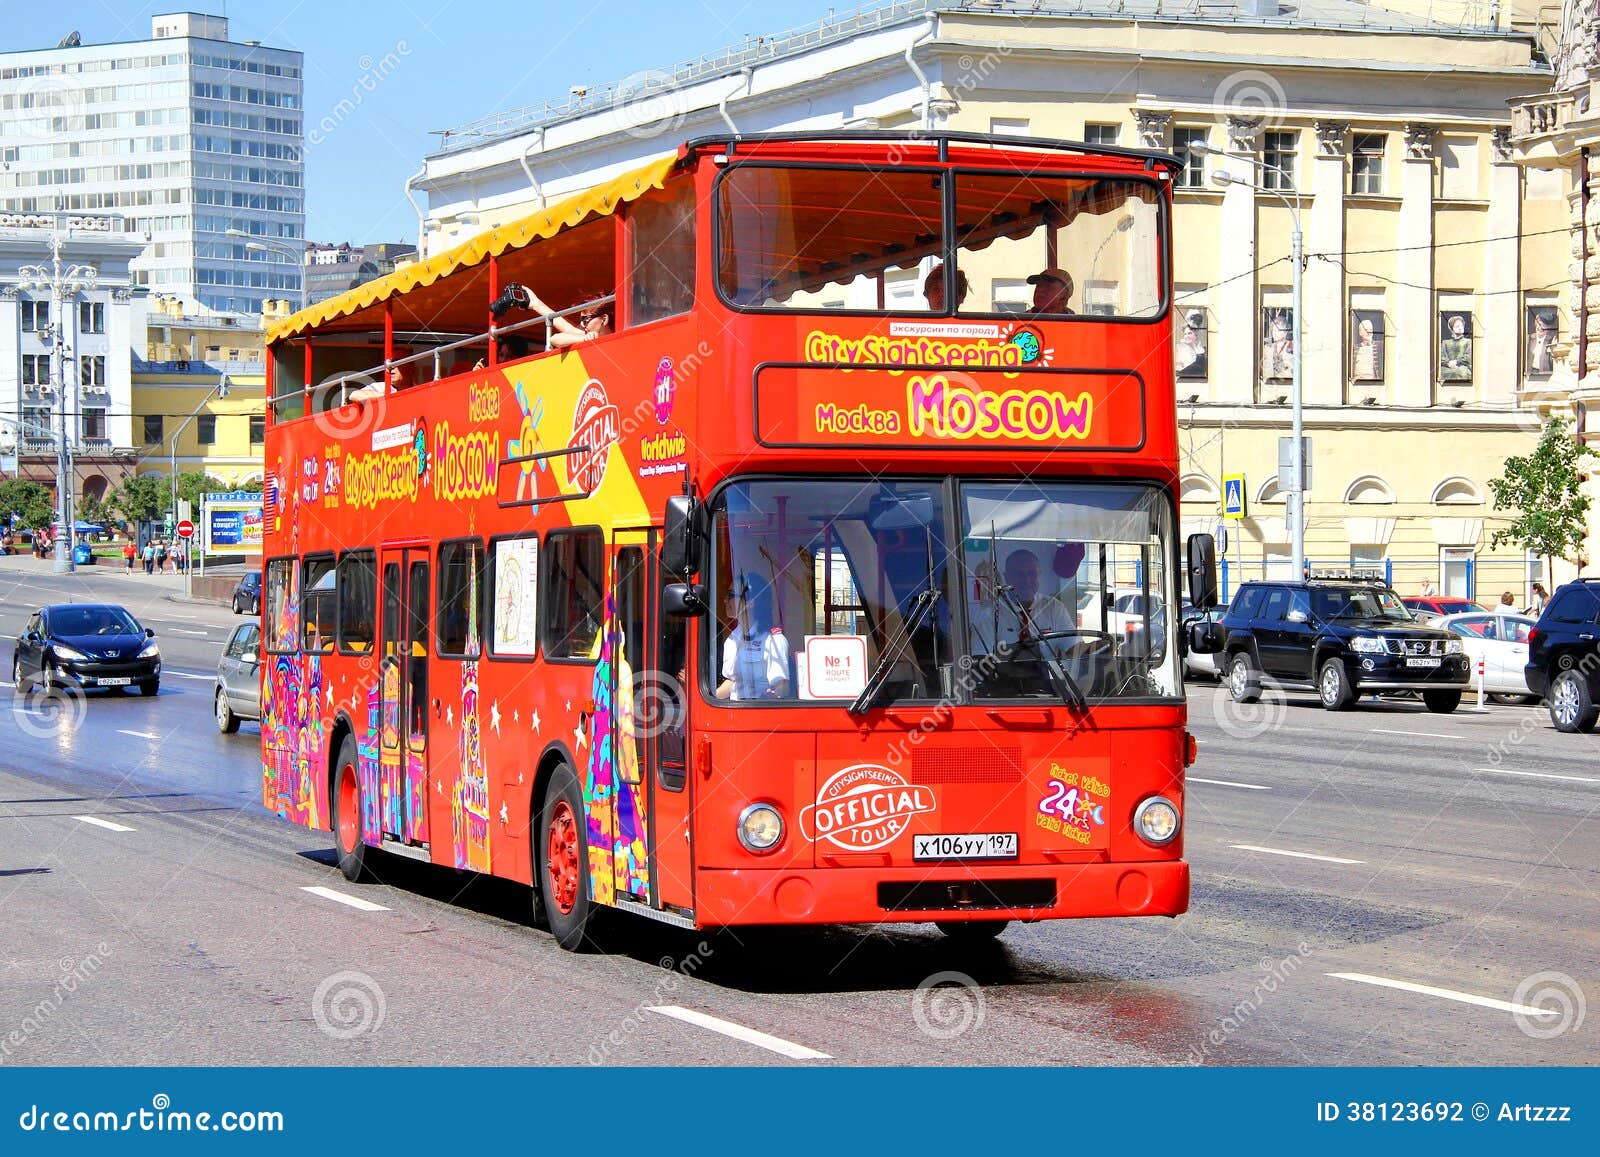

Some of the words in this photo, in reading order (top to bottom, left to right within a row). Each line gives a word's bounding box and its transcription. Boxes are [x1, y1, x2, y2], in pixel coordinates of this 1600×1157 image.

[961, 327, 996, 335] городу
[815, 403, 901, 434] Москва
[641, 430, 686, 461] Worldwide
[829, 770, 899, 797] CITYSIGHTSEEING
[815, 789, 928, 832] OFFICIAL
[850, 820, 901, 844] TOUR
[988, 835, 1013, 849] 197
